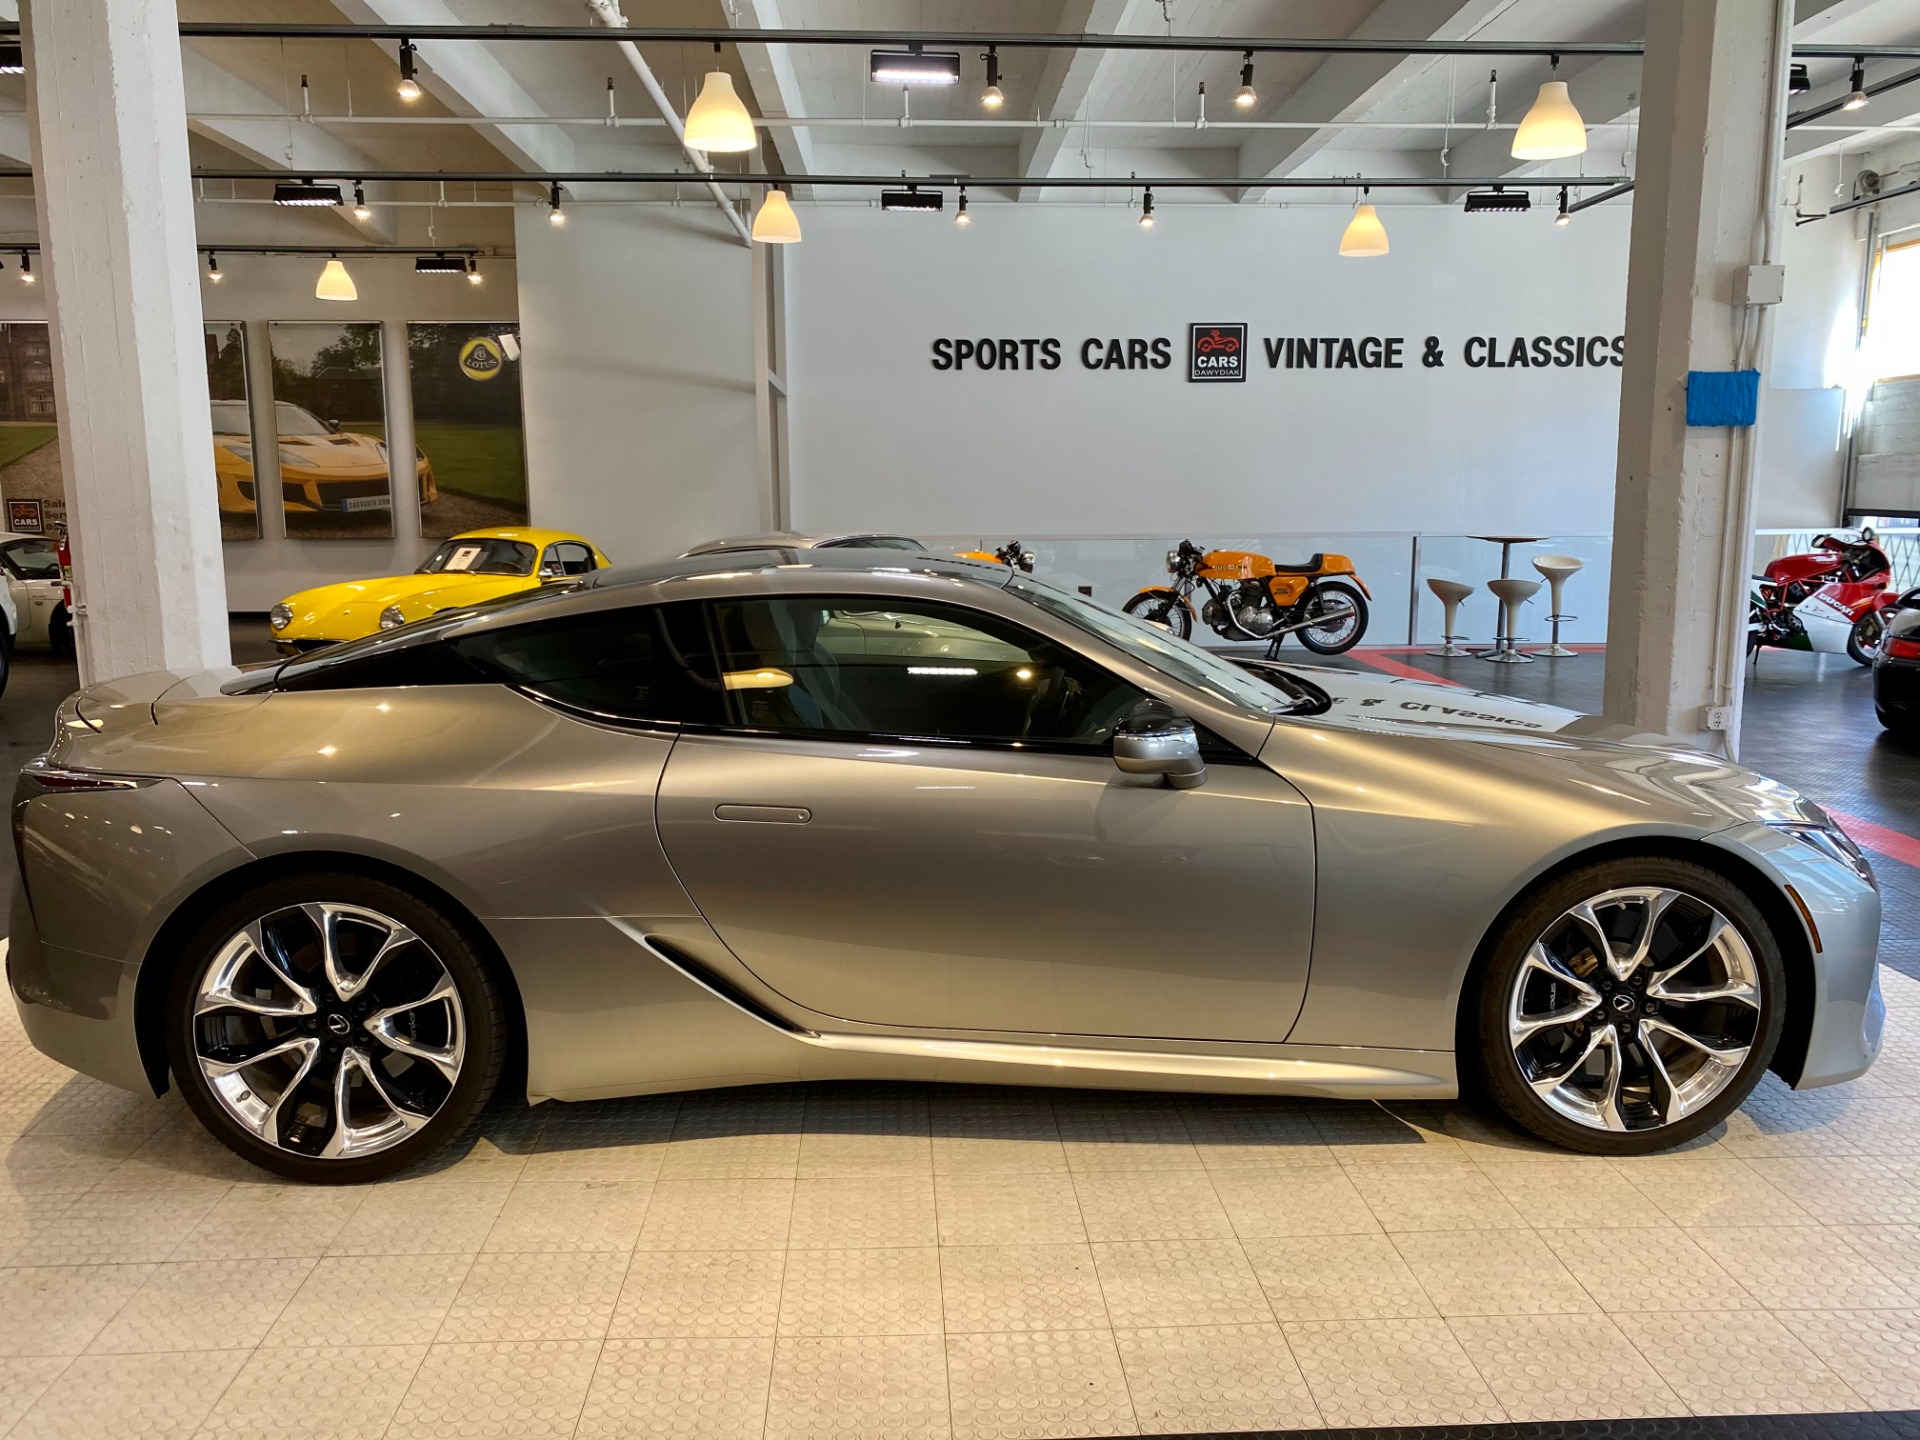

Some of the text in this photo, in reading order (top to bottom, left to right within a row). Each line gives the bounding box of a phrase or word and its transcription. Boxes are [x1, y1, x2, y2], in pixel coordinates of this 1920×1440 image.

[931, 337, 1171, 371] SPORTS CARS
[1263, 335, 1625, 369] VINTAGE & CLASSICS
[466, 358, 497, 369] LOTUS
[1197, 356, 1238, 368] CARS
[44, 500, 66, 508] Sale
[1818, 592, 1855, 616] DUCATI
